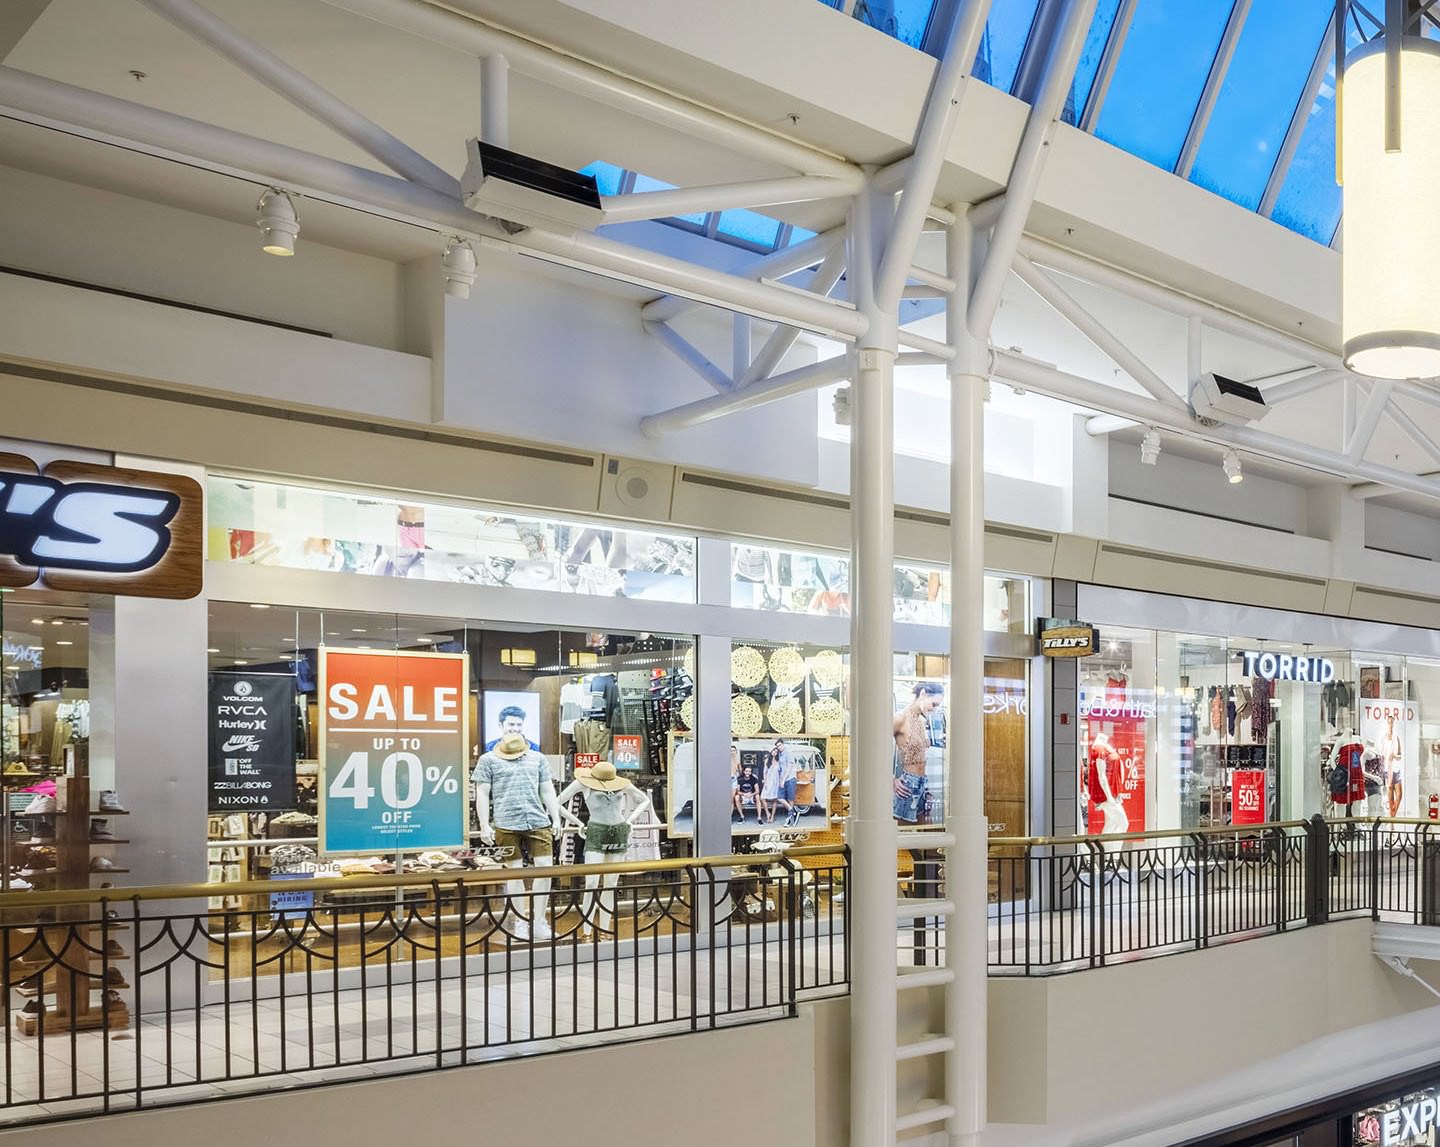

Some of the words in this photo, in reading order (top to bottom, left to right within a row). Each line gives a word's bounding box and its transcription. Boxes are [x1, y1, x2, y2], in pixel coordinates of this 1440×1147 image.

[0, 481, 169, 564] 'S
[1243, 651, 1335, 683] TORRID
[328, 683, 459, 722] SALE
[217, 705, 268, 716] RVCA
[1364, 706, 1417, 721] TORRID
[218, 719, 254, 730] Hurley
[229, 735, 256, 744] NIKE
[373, 738, 395, 750] UP
[400, 738, 422, 750] TO
[617, 739, 638, 747] SALE
[577, 755, 598, 764] SALE
[328, 751, 458, 810] 40%
[1125, 781, 1139, 790] OFF
[218, 796, 259, 804] NIXON
[382, 811, 412, 824] OFF
